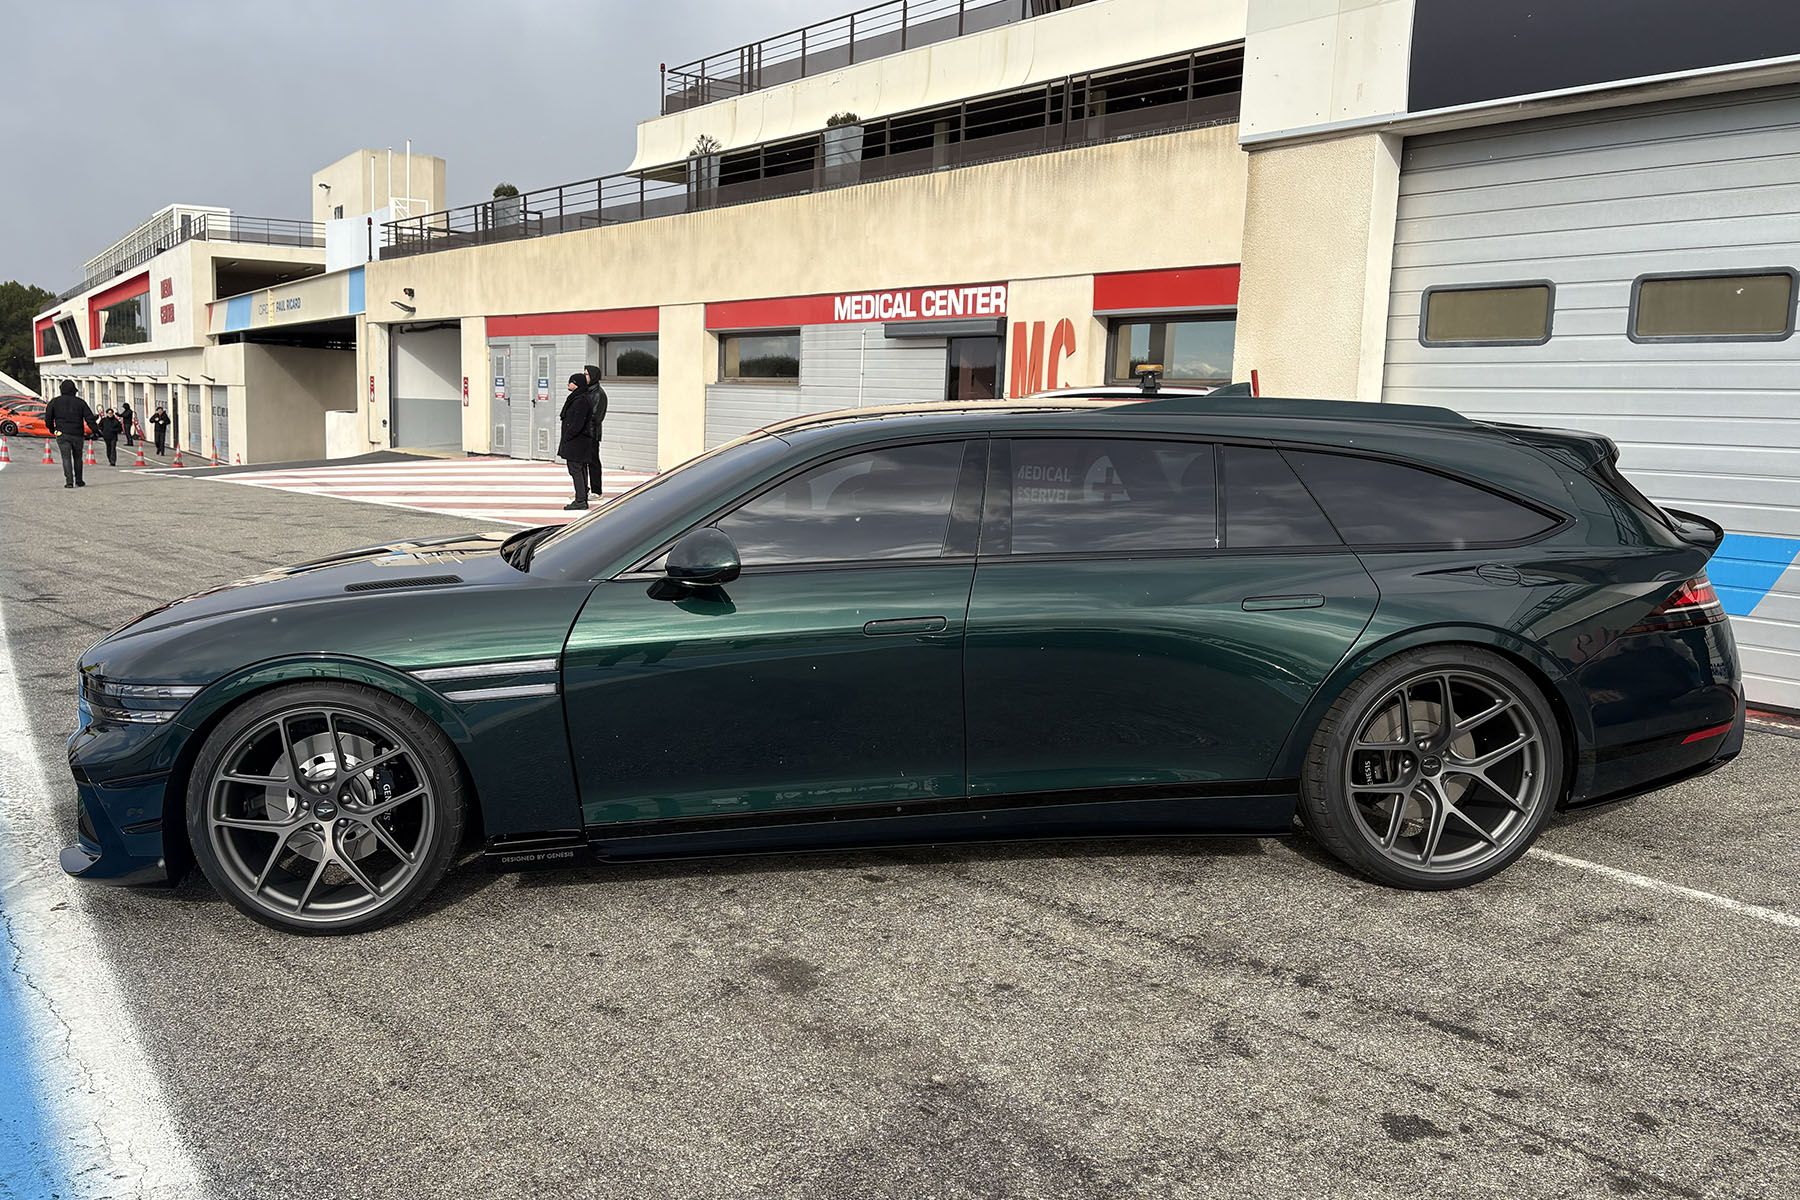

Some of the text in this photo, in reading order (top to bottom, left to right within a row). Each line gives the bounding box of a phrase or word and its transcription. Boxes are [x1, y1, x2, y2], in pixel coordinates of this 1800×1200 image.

[276, 300, 286, 312] PAUL
[286, 297, 301, 310] RICARD
[834, 285, 1007, 321] MEDICAL CENTER
[1009, 317, 1077, 399] MC
[1364, 760, 1374, 786] ENESIS
[382, 783, 392, 821] GENIS
[501, 854, 535, 863] DESIGNED
[546, 851, 574, 860] GENESIS
